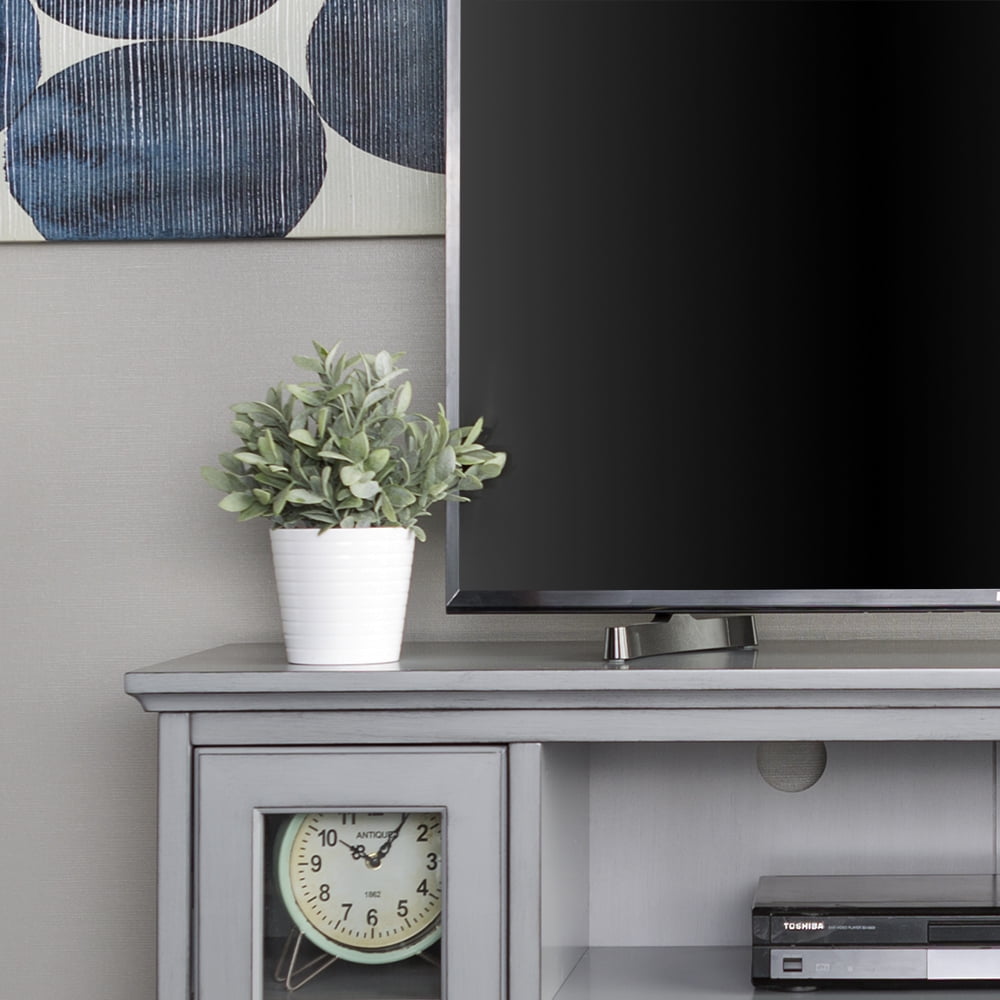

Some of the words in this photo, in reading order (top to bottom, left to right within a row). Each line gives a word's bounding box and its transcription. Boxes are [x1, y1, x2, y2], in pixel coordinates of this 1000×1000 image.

[318, 829, 337, 847] 10
[416, 824, 429, 842] 2
[311, 855, 322, 872] 9
[426, 853, 438, 870] 3
[319, 884, 330, 901] 8
[416, 879, 429, 896] 4
[341, 904, 353, 921] 7
[397, 900, 408, 917] 5
[366, 909, 378, 926] 6
[783, 921, 825, 930] TOSHIBA
